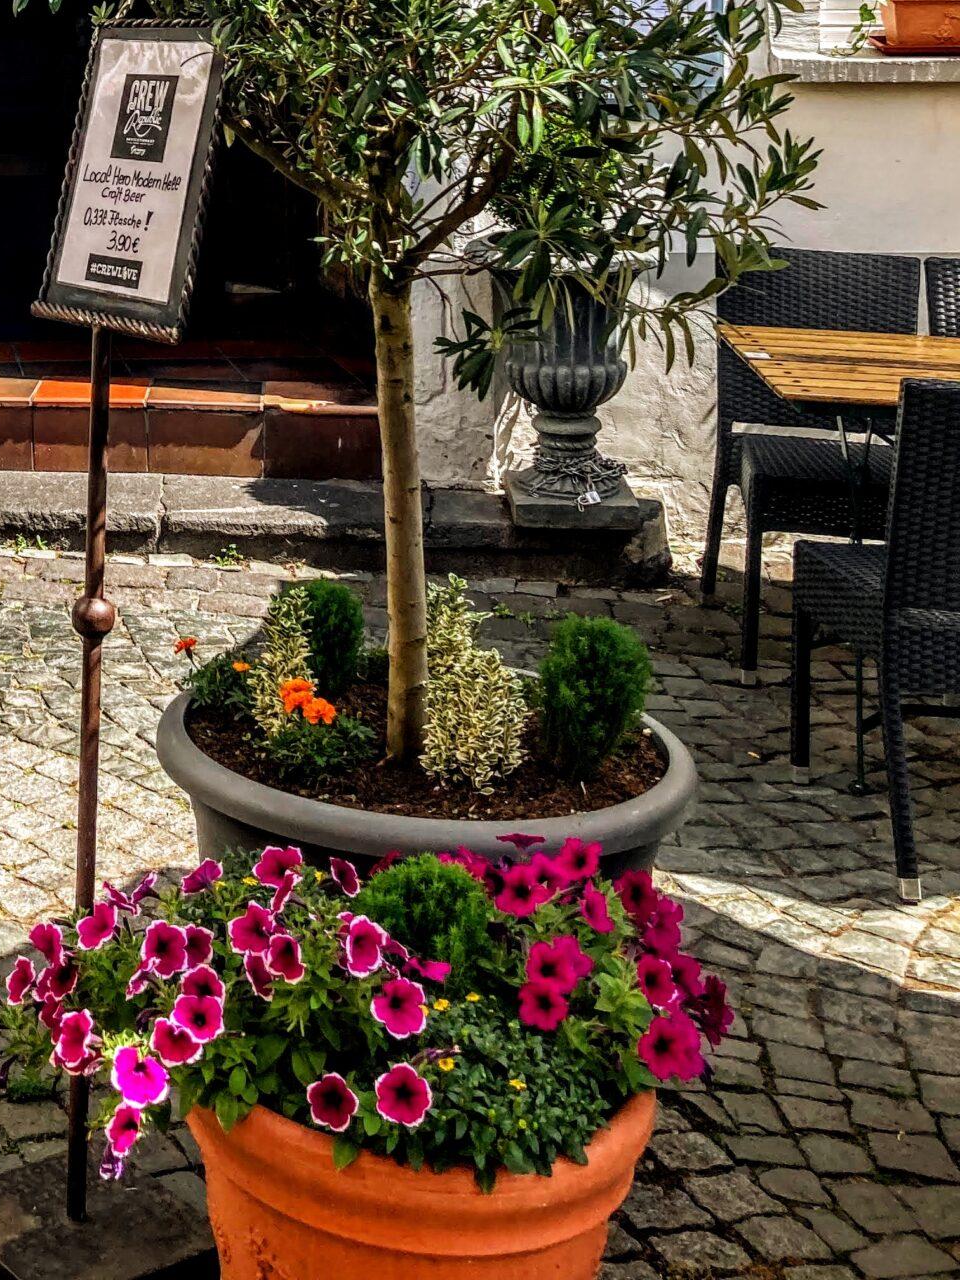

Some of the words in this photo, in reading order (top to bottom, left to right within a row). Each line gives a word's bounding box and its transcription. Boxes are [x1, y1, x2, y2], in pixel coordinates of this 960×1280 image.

[126, 79, 170, 114] CREW
[83, 163, 112, 183] Local
[112, 166, 130, 186] Hero
[131, 170, 160, 189] Modern
[161, 172, 182, 191] Hell
[101, 186, 123, 205] Craft
[123, 188, 146, 203] Beer
[108, 209, 142, 229] Flasche
